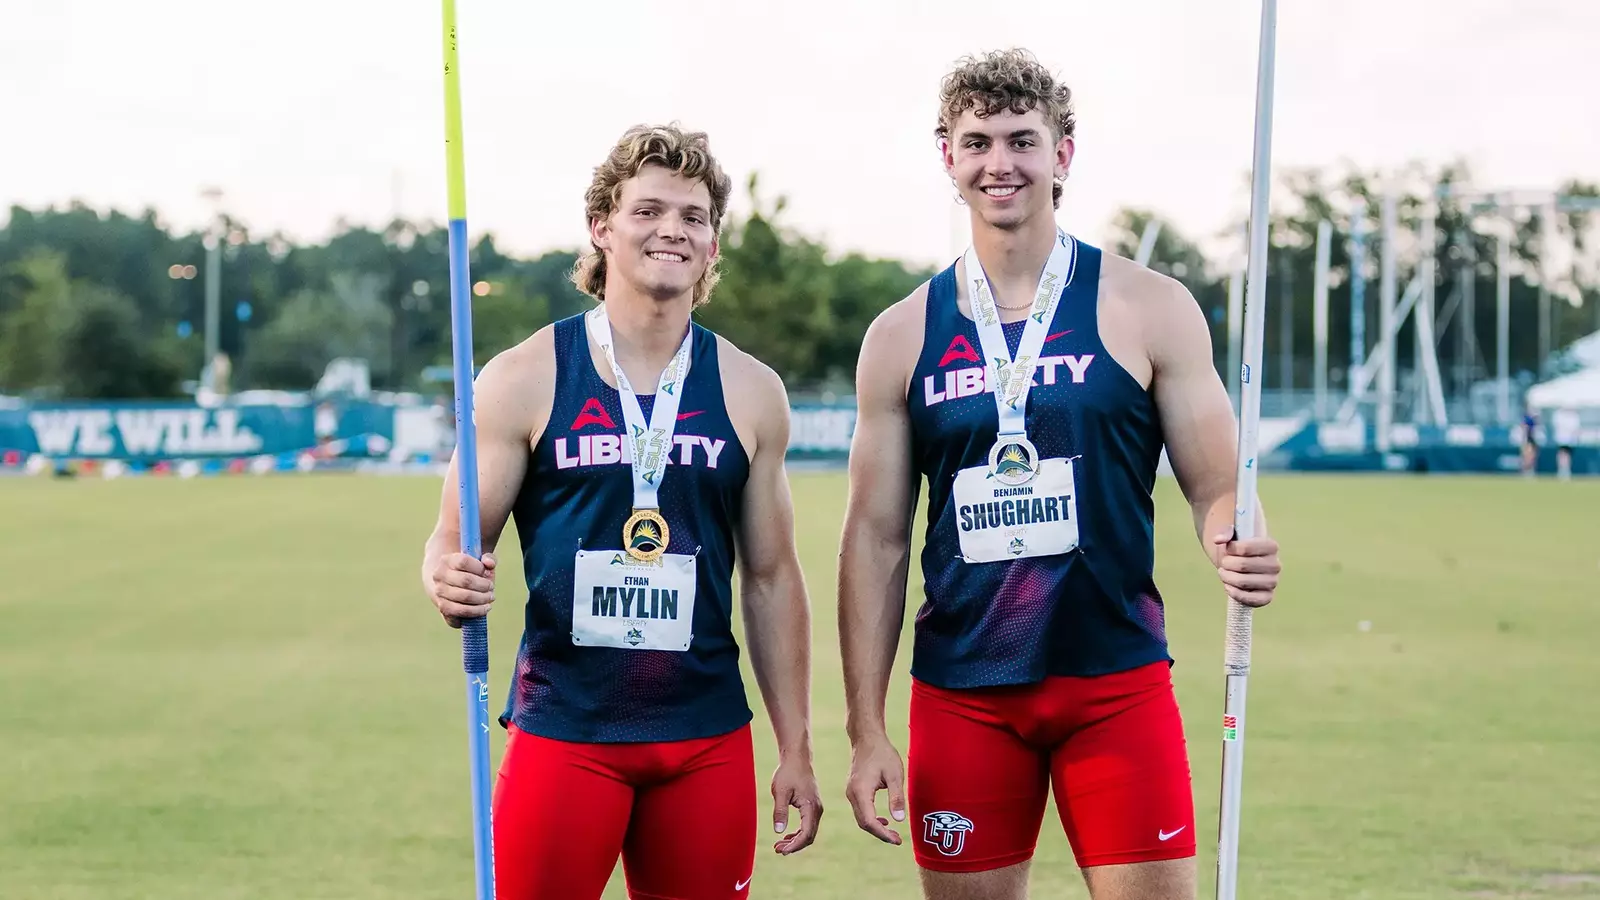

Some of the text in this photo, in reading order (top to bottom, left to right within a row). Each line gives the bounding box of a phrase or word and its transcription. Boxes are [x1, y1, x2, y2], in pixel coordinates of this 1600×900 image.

[1032, 272, 1057, 324] ASUN
[29, 409, 262, 455] WE WILL
[642, 428, 666, 485] ASUN
[994, 487, 1033, 497] BENJAMIN
[960, 495, 1071, 532] SHUGHART
[624, 577, 649, 586] ETHAN
[592, 586, 678, 619] MYLIN
